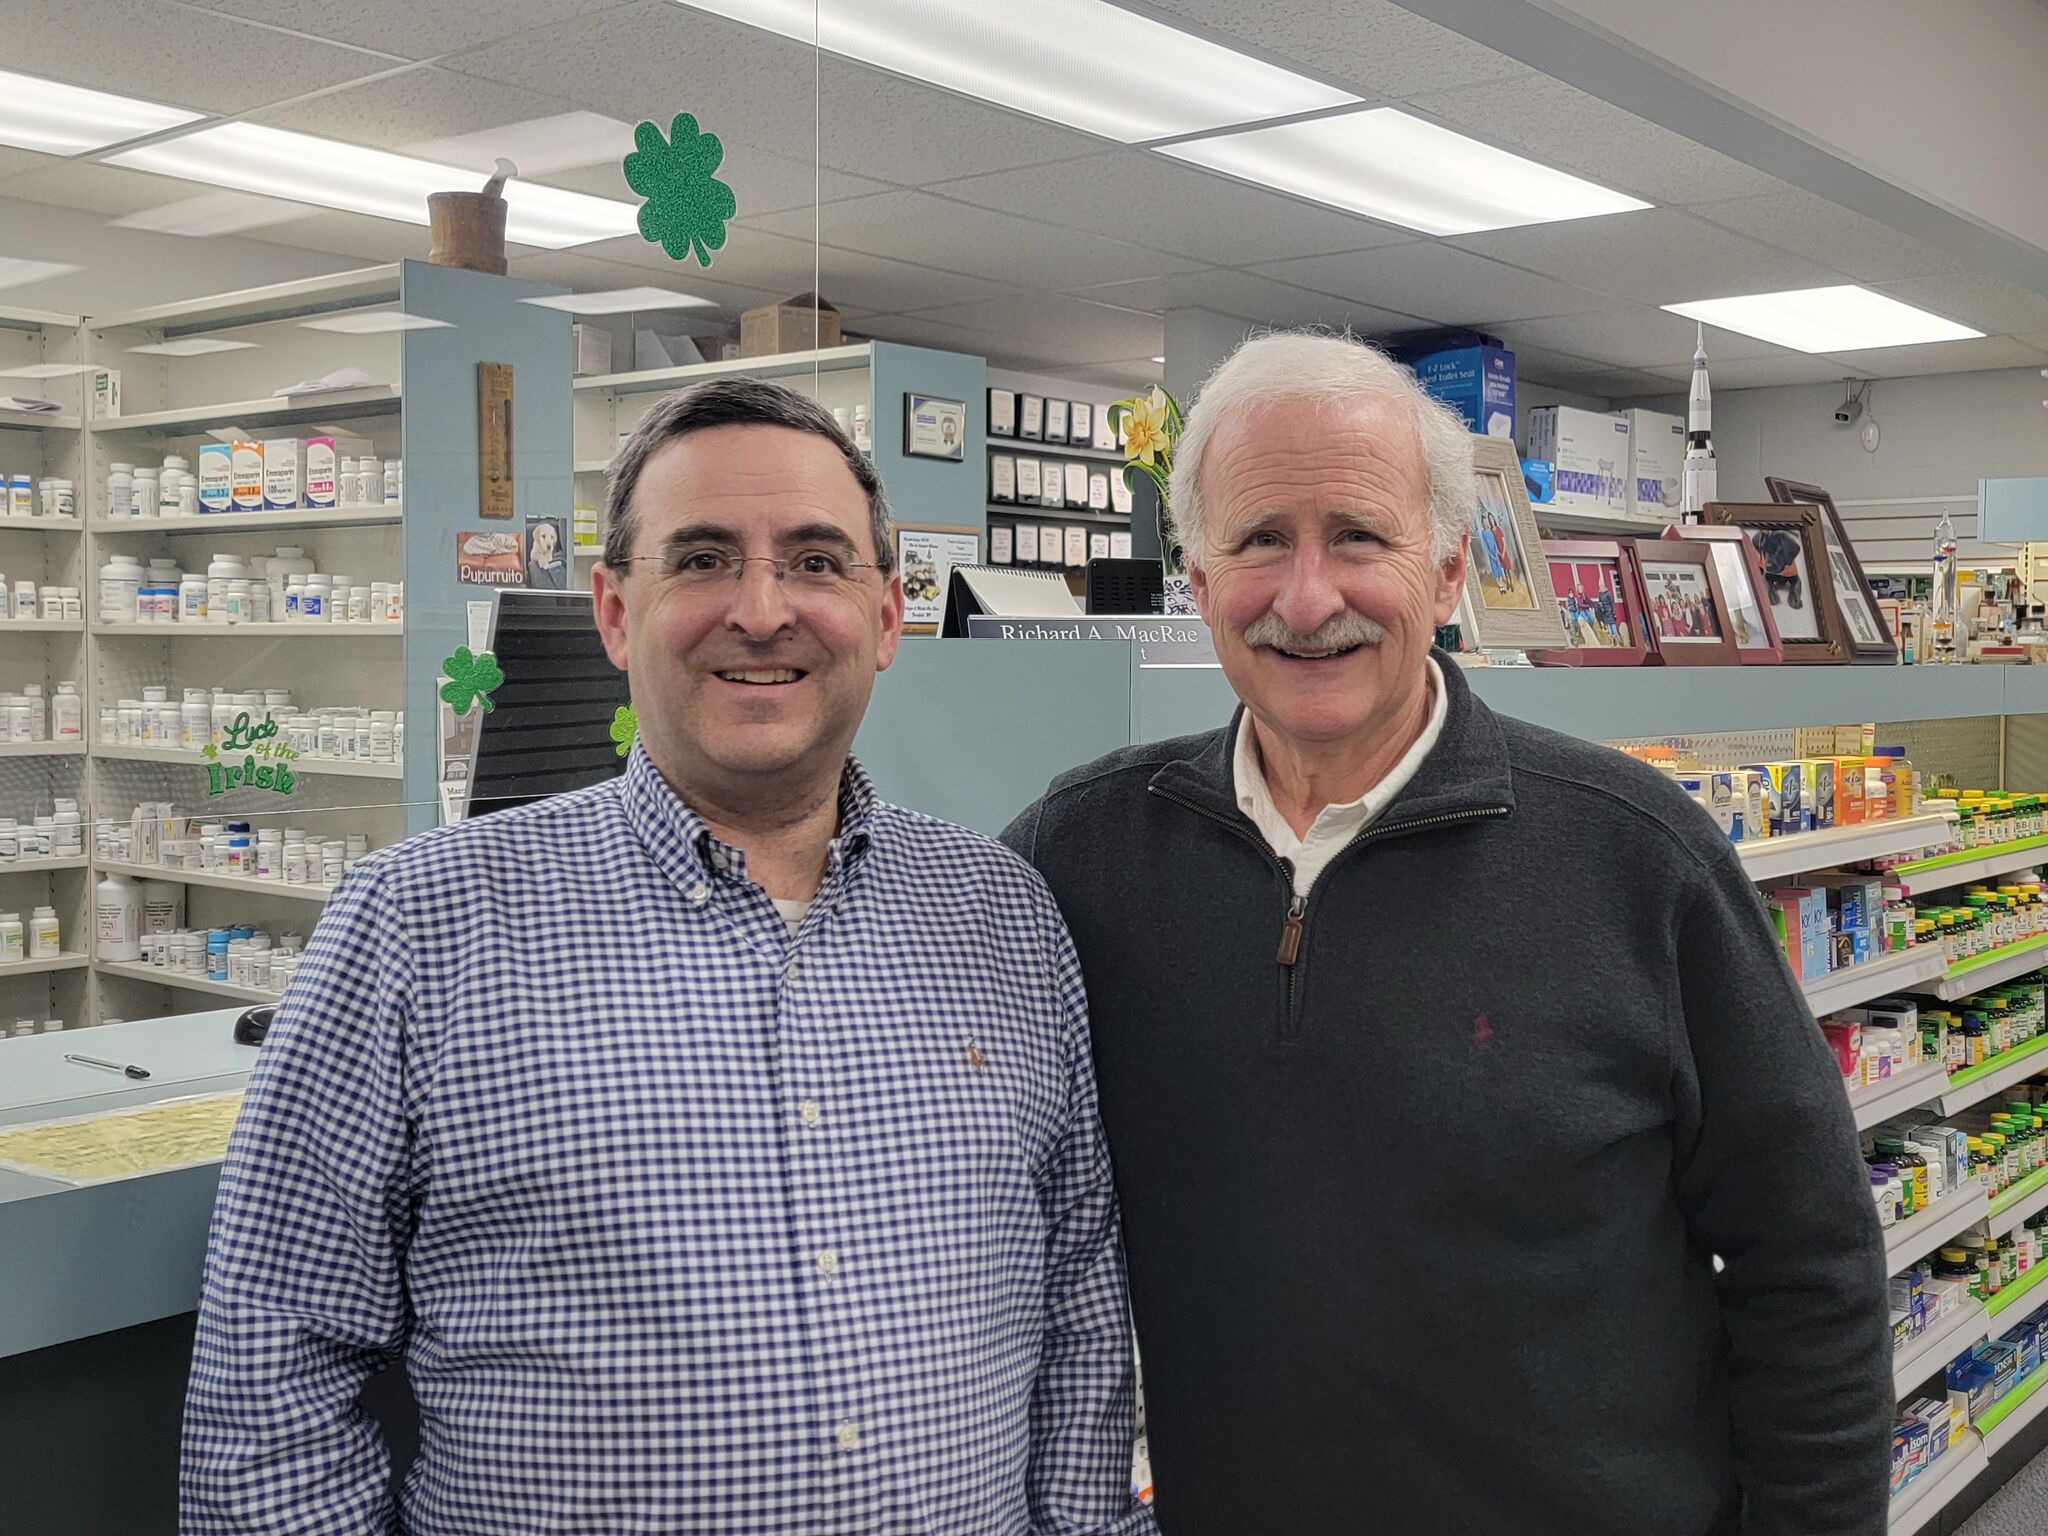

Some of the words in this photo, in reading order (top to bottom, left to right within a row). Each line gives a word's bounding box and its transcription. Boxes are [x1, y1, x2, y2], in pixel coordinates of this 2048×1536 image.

[460, 565, 523, 585] Pupurruito
[1000, 624, 1080, 640] Richard
[1114, 625, 1198, 642] MacRae
[222, 711, 278, 750] Luck
[255, 741, 271, 761] of
[273, 742, 299, 762] the
[207, 755, 295, 795] Irish
